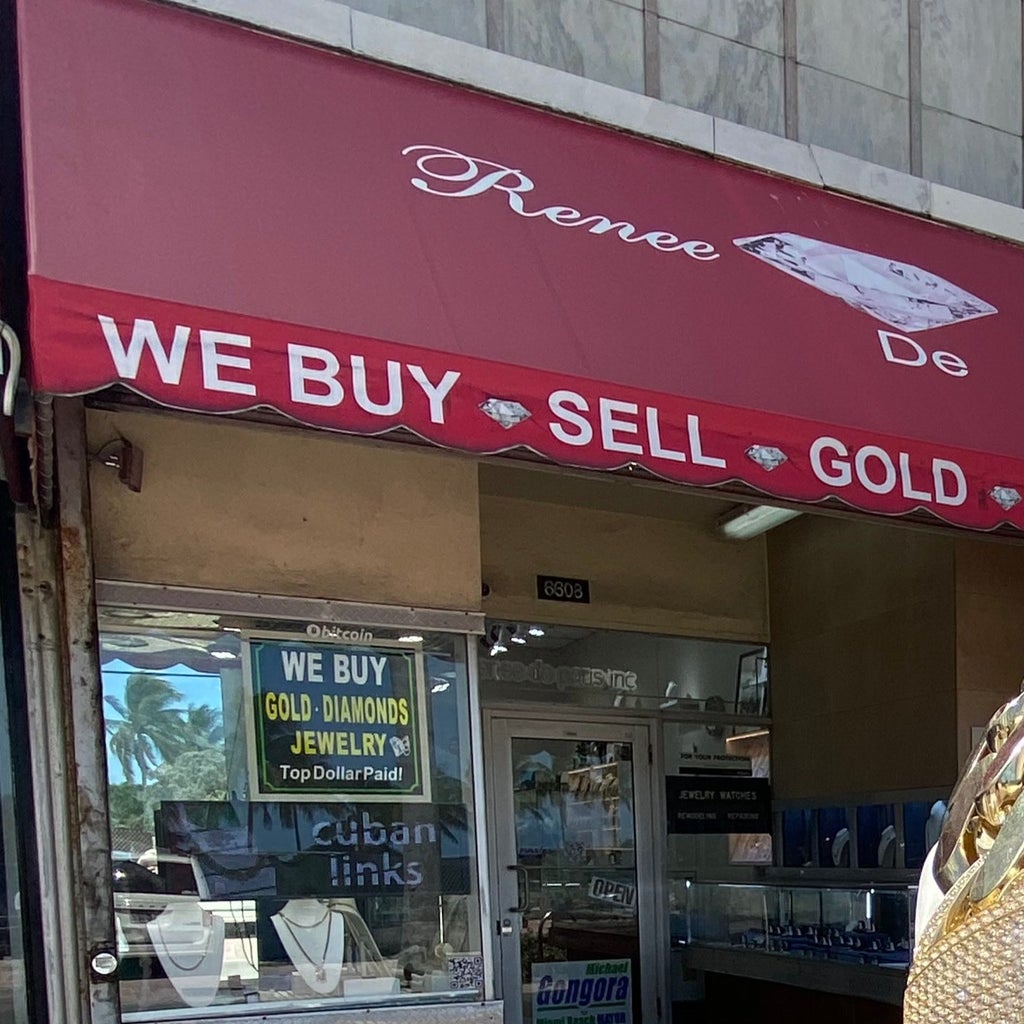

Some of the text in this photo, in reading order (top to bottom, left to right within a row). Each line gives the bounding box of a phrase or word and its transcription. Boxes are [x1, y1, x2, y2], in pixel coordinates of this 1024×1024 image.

[402, 145, 720, 262] Renee
[876, 330, 969, 378] De
[97, 314, 257, 398] WE
[287, 343, 461, 424] BUY
[548, 390, 726, 469] SELL
[809, 436, 968, 507] GOLD
[321, 625, 374, 642] bitcoin
[281, 650, 387, 686] WE BUY
[265, 691, 409, 726] GOLD DIAMONDS
[290, 731, 387, 757] JEWELRY
[280, 764, 403, 783] Top Dollar Paid!
[678, 789, 758, 801] JEWELRY WATCHES
[312, 811, 437, 846] cuban
[330, 851, 424, 887] links
[593, 878, 635, 905] OPEN
[586, 961, 629, 975] Michael
[536, 975, 630, 1007] Gongora
